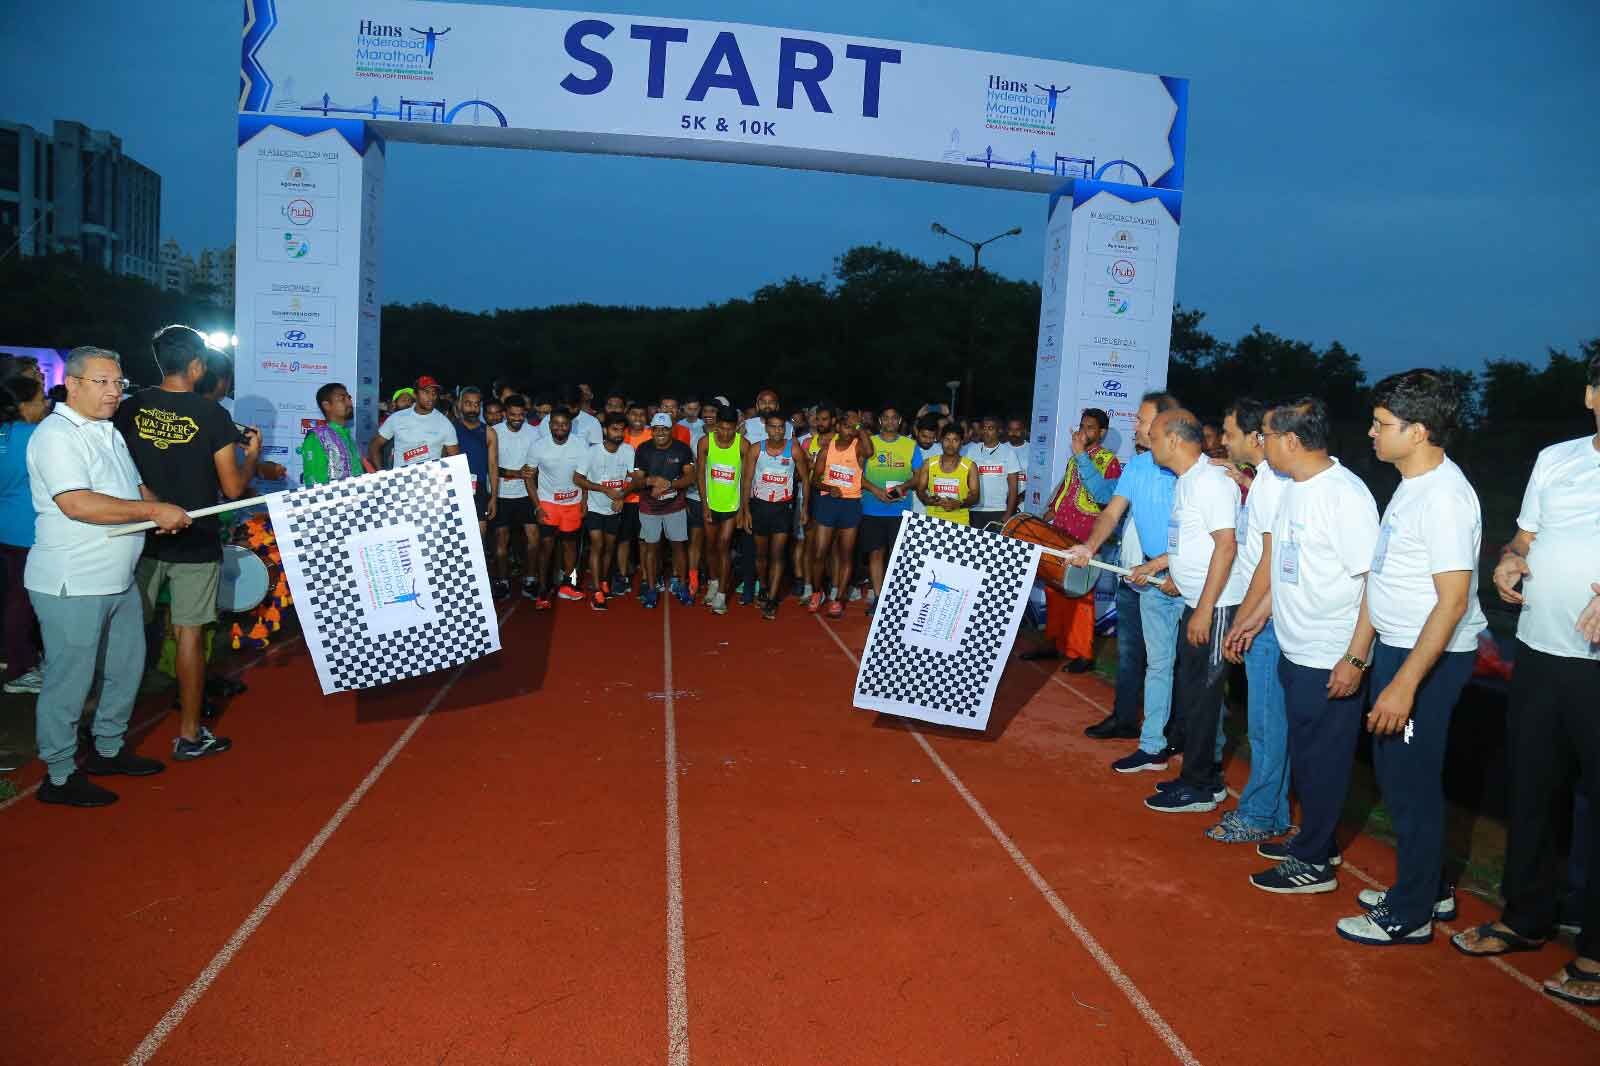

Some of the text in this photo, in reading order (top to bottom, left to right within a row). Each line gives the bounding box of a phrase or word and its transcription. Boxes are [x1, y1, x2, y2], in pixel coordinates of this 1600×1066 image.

[359, 19, 402, 37] Hans
[356, 35, 425, 49] Hyderabad
[356, 48, 424, 63] Marathon
[559, 19, 902, 119] START
[989, 74, 1028, 92] Hans
[987, 88, 1048, 105] Hyderabad
[986, 102, 1047, 119] Marathon
[681, 114, 777, 136] 5K & 10K
[1095, 390, 1128, 399] HYUNDAI
[160, 421, 192, 436] THERE
[396, 538, 413, 574] Hans
[911, 601, 931, 633] Hans
